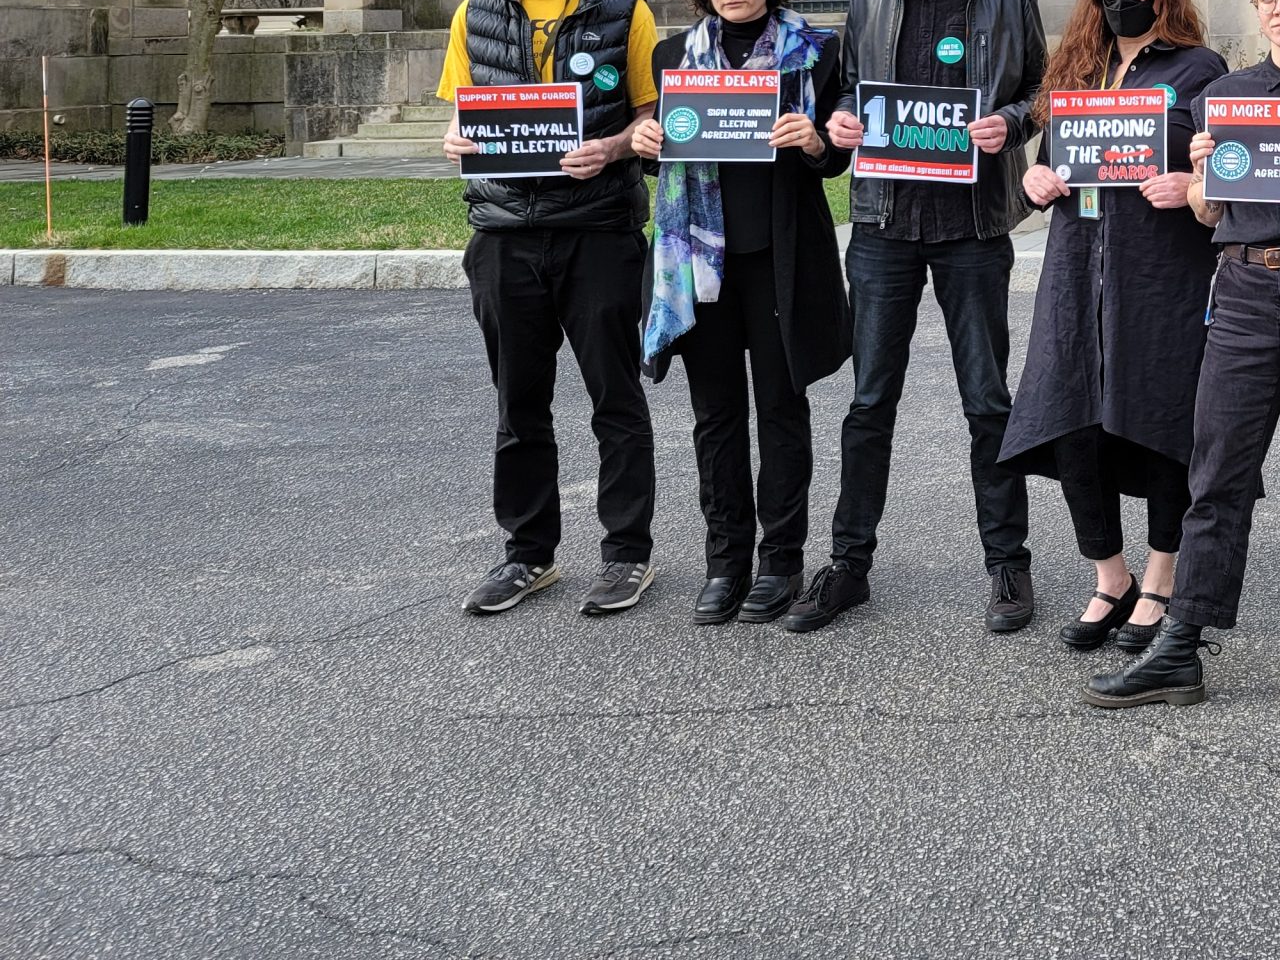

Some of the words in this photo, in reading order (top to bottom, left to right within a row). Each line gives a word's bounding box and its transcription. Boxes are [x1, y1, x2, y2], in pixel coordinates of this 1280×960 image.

[665, 75, 681, 86] NO
[685, 75, 720, 86] MORE
[725, 75, 778, 87] DELAYS!
[459, 93, 498, 102] SUPPORT
[501, 92, 517, 101] THE
[520, 92, 539, 100] BMA
[542, 92, 576, 100] GUARDS
[1053, 98, 1066, 107] NO
[1070, 98, 1082, 107] TO
[1086, 97, 1115, 106] UNION
[1120, 96, 1162, 106] BUSTING
[747, 109, 771, 117] UNION
[897, 100, 968, 127] VOICE
[1209, 104, 1227, 117] NO
[1232, 104, 1271, 118] MORE
[862, 95, 889, 147] 1
[1060, 119, 1156, 138] GUARDING
[461, 122, 577, 138] WALL-TO-WALL
[702, 131, 752, 139] AGREEMENT
[893, 124, 968, 152] UNION
[511, 139, 578, 154] ELECTION
[1066, 146, 1101, 164] THE
[1109, 144, 1150, 164] ART
[859, 162, 874, 170] Sign
[888, 164, 915, 173] election
[916, 167, 952, 175] agreement
[1098, 165, 1158, 180] GUARDS
